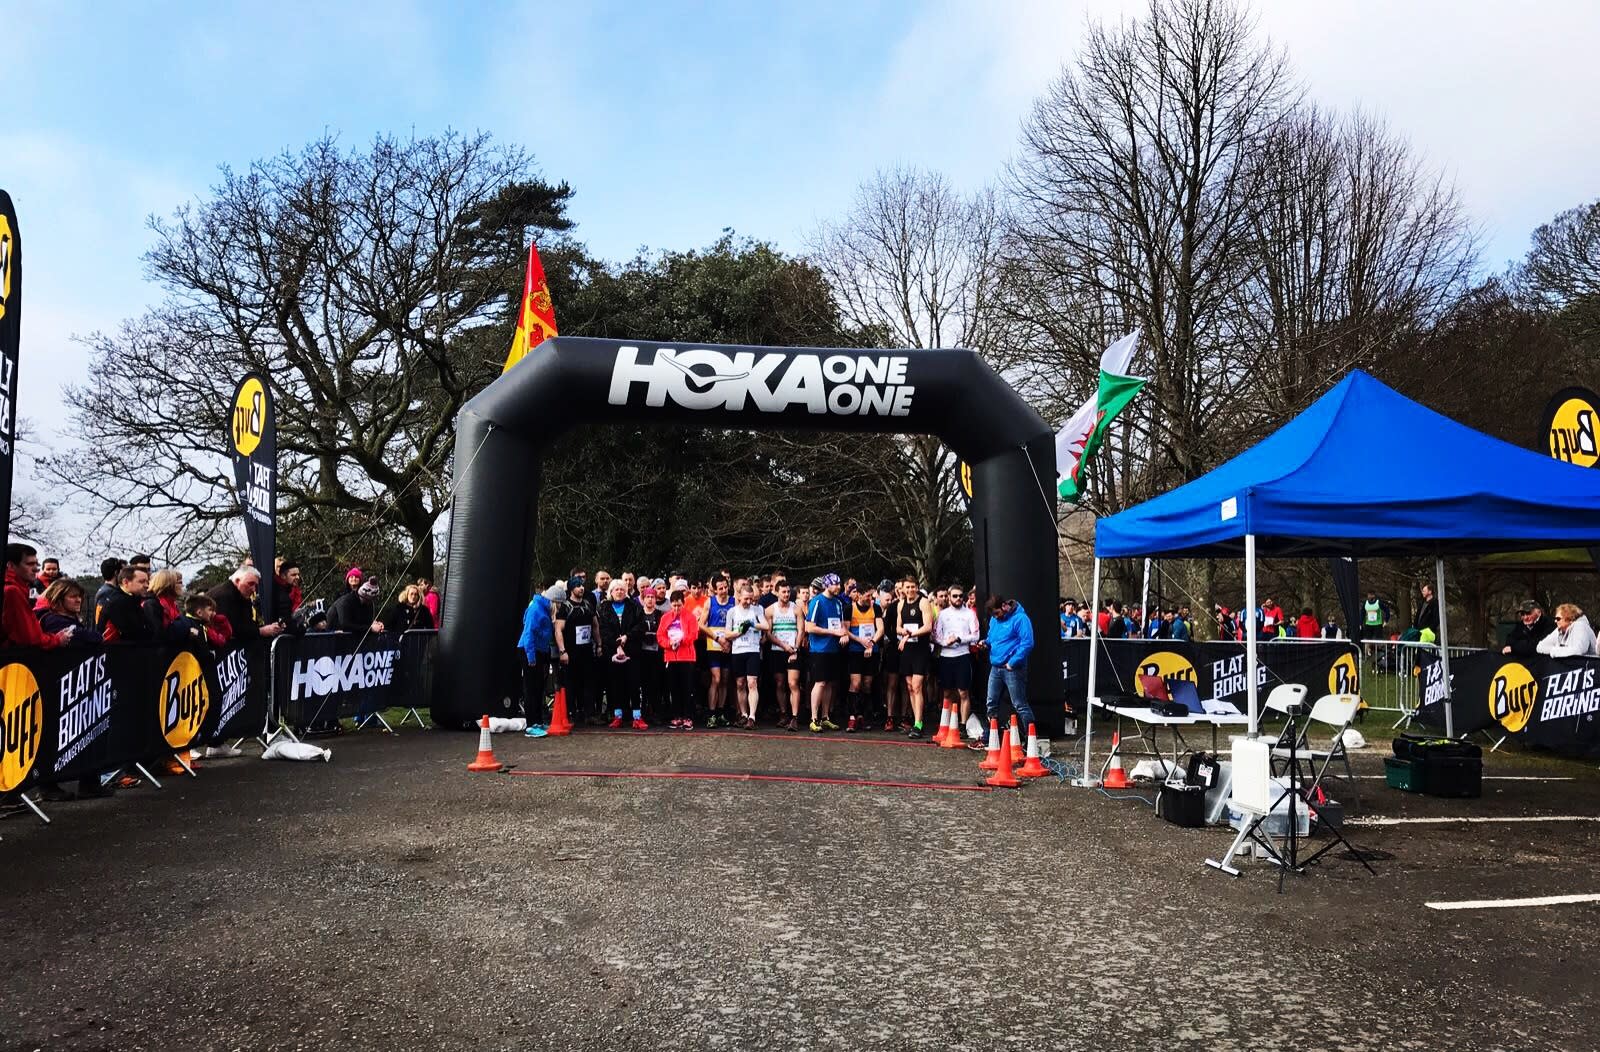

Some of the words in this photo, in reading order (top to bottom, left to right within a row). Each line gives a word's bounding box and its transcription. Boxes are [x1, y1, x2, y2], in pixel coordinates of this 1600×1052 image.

[608, 346, 827, 413] HOKA
[823, 355, 909, 385] ONE
[827, 385, 916, 416] ONE
[60, 656, 95, 712] FLAT
[94, 653, 107, 685] IS
[290, 653, 365, 700] HOKA
[364, 650, 395, 670] ONE
[364, 668, 394, 688] ONE
[1213, 654, 1245, 680] FLAT
[1545, 668, 1583, 698] FLAT
[1582, 668, 1595, 690] IS
